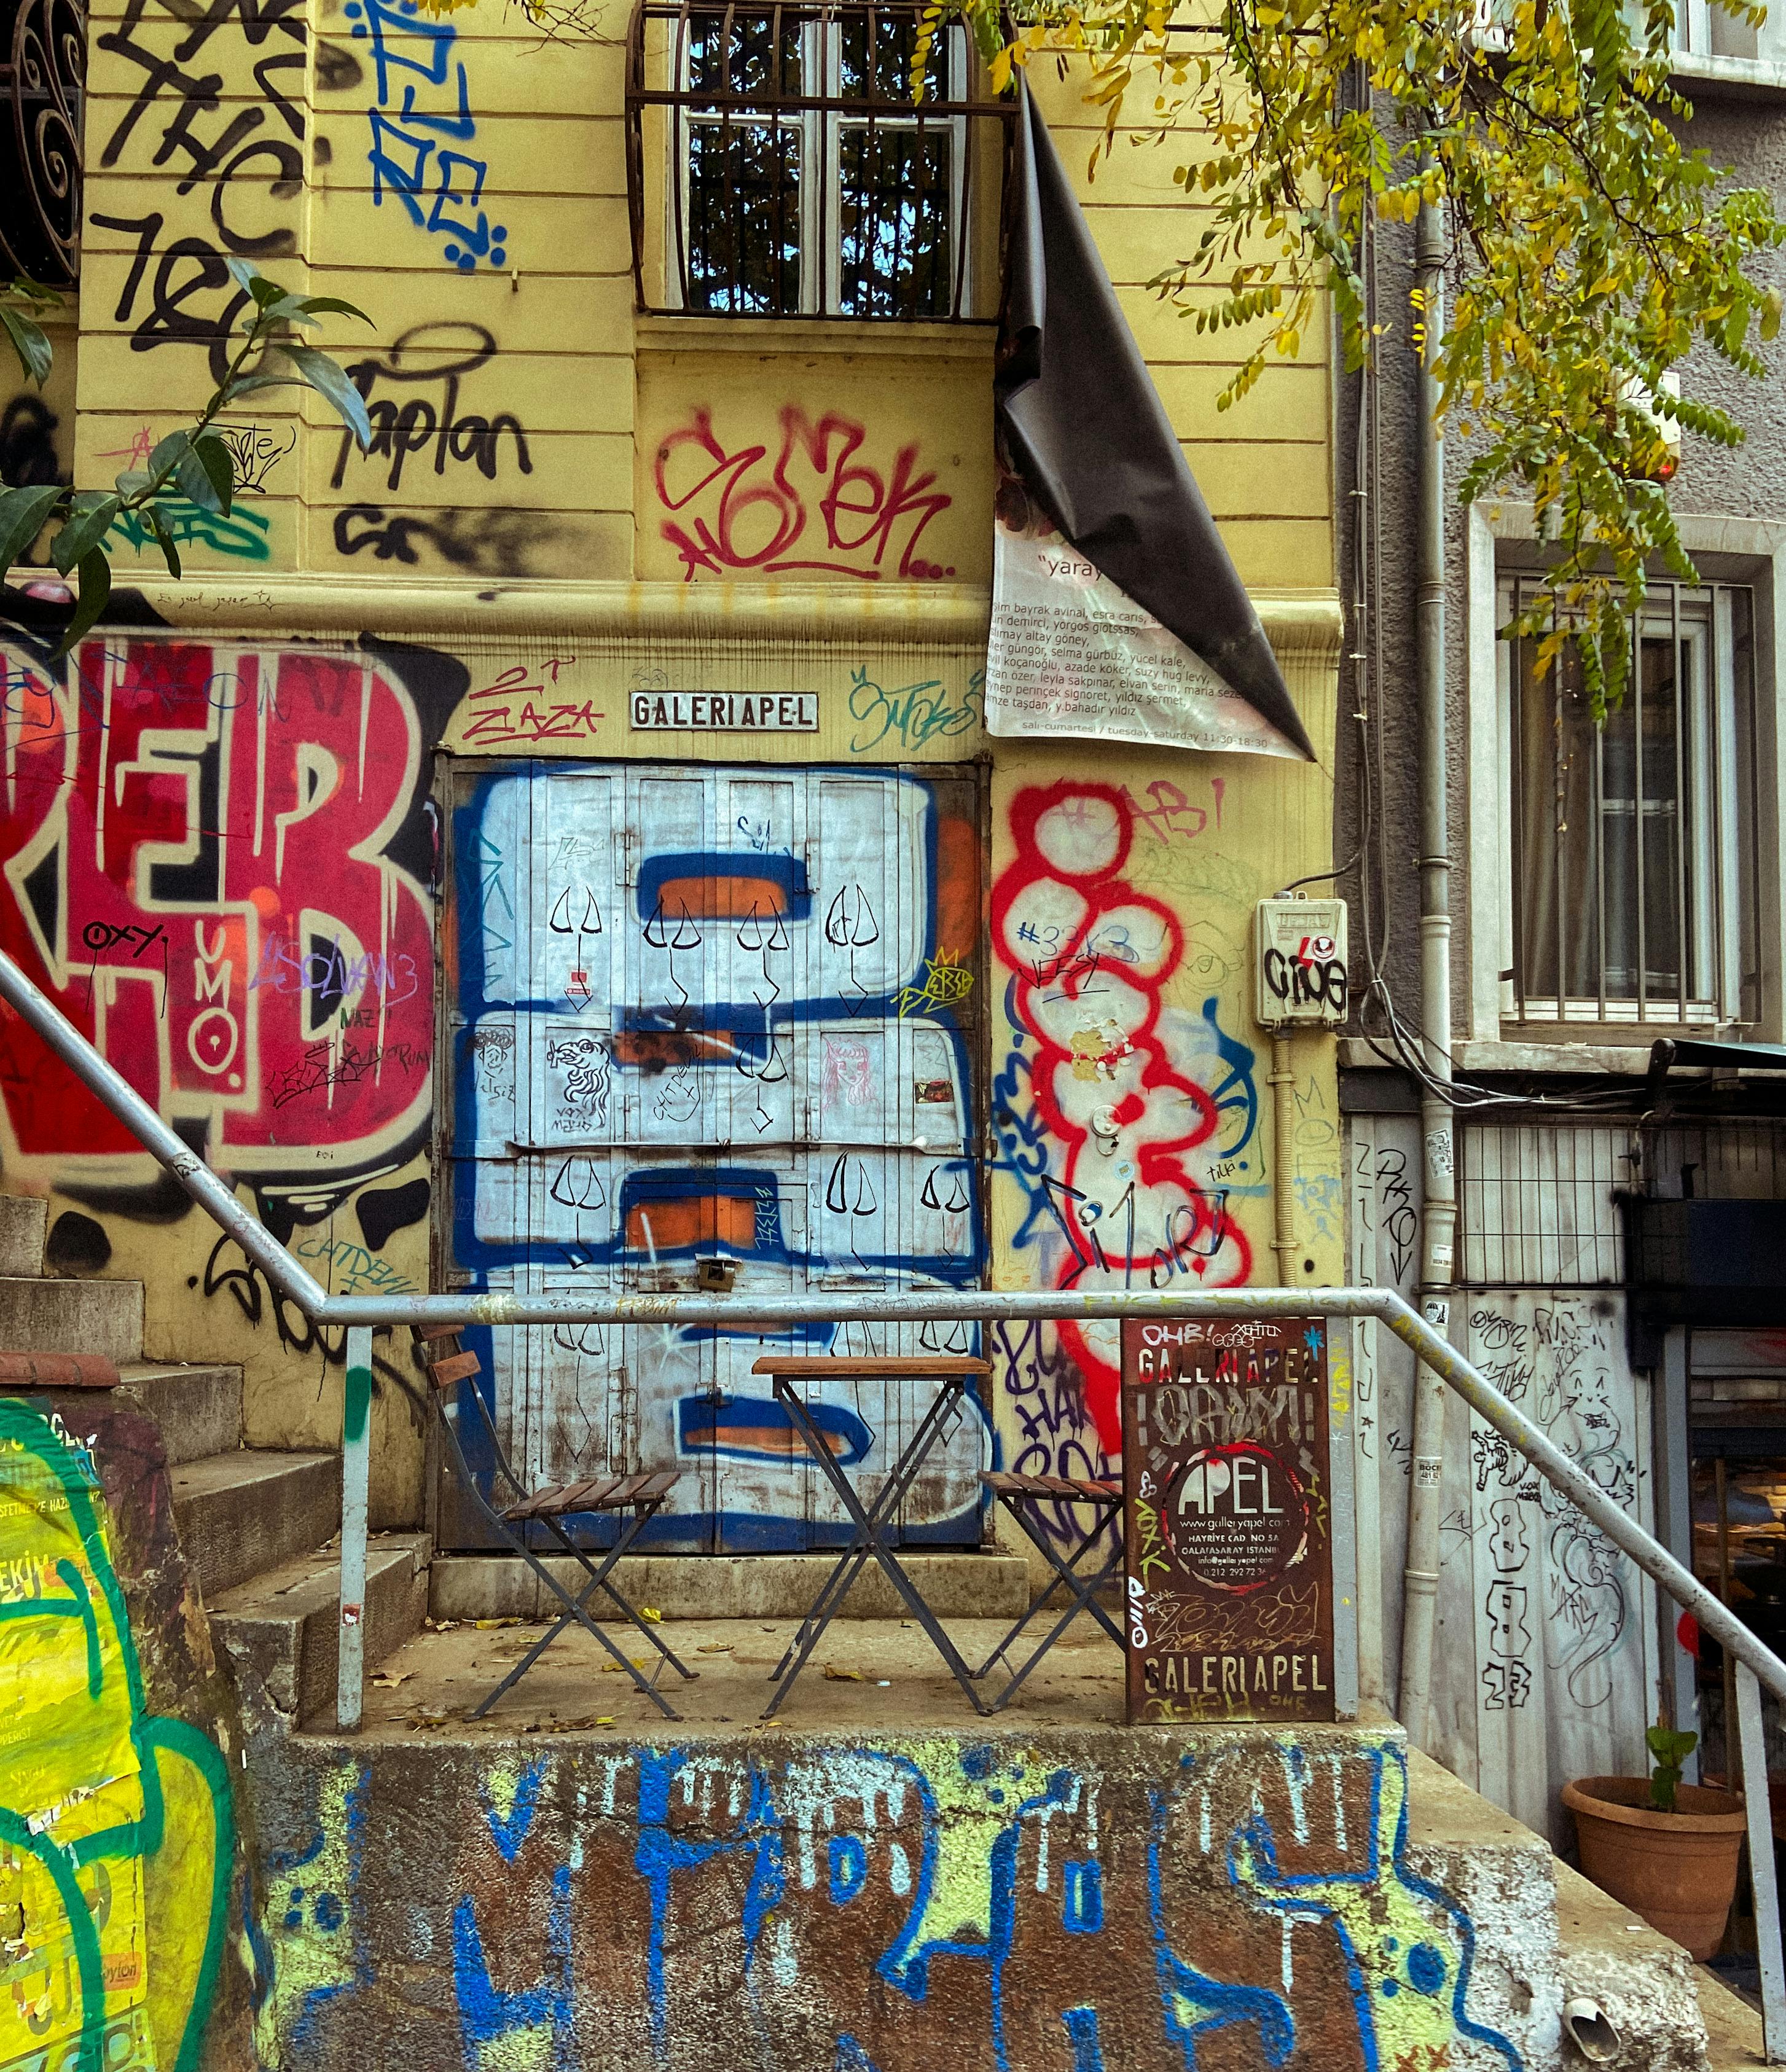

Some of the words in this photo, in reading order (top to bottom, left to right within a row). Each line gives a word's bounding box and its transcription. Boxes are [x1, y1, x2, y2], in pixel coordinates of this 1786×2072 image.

[1014, 603, 1050, 615] bayrak
[1092, 611, 1114, 620] esra
[1054, 621, 1089, 633] yorgos
[1026, 631, 1052, 643] altay
[1056, 633, 1090, 648] göney,
[1008, 644, 1047, 657] güngör,
[1051, 648, 1082, 659] selma
[1130, 654, 1157, 665] yücel
[1161, 655, 1186, 669] kale,
[1004, 656, 1060, 672] koçanoğlu,
[1065, 662, 1097, 673] azade
[1135, 668, 1159, 679] suzy
[1162, 668, 1181, 682] hug
[1186, 671, 1210, 685] levy,
[1040, 672, 1065, 685] leyla
[1119, 678, 1148, 689] elvan
[1185, 686, 1214, 696] maria
[1218, 688, 1242, 699] seze
[1012, 698, 1052, 712] taşdan,
[1108, 705, 1137, 717] yıldız
[1115, 692, 1143, 704] yıldız
[1178, 1456, 1285, 1515] APEL
